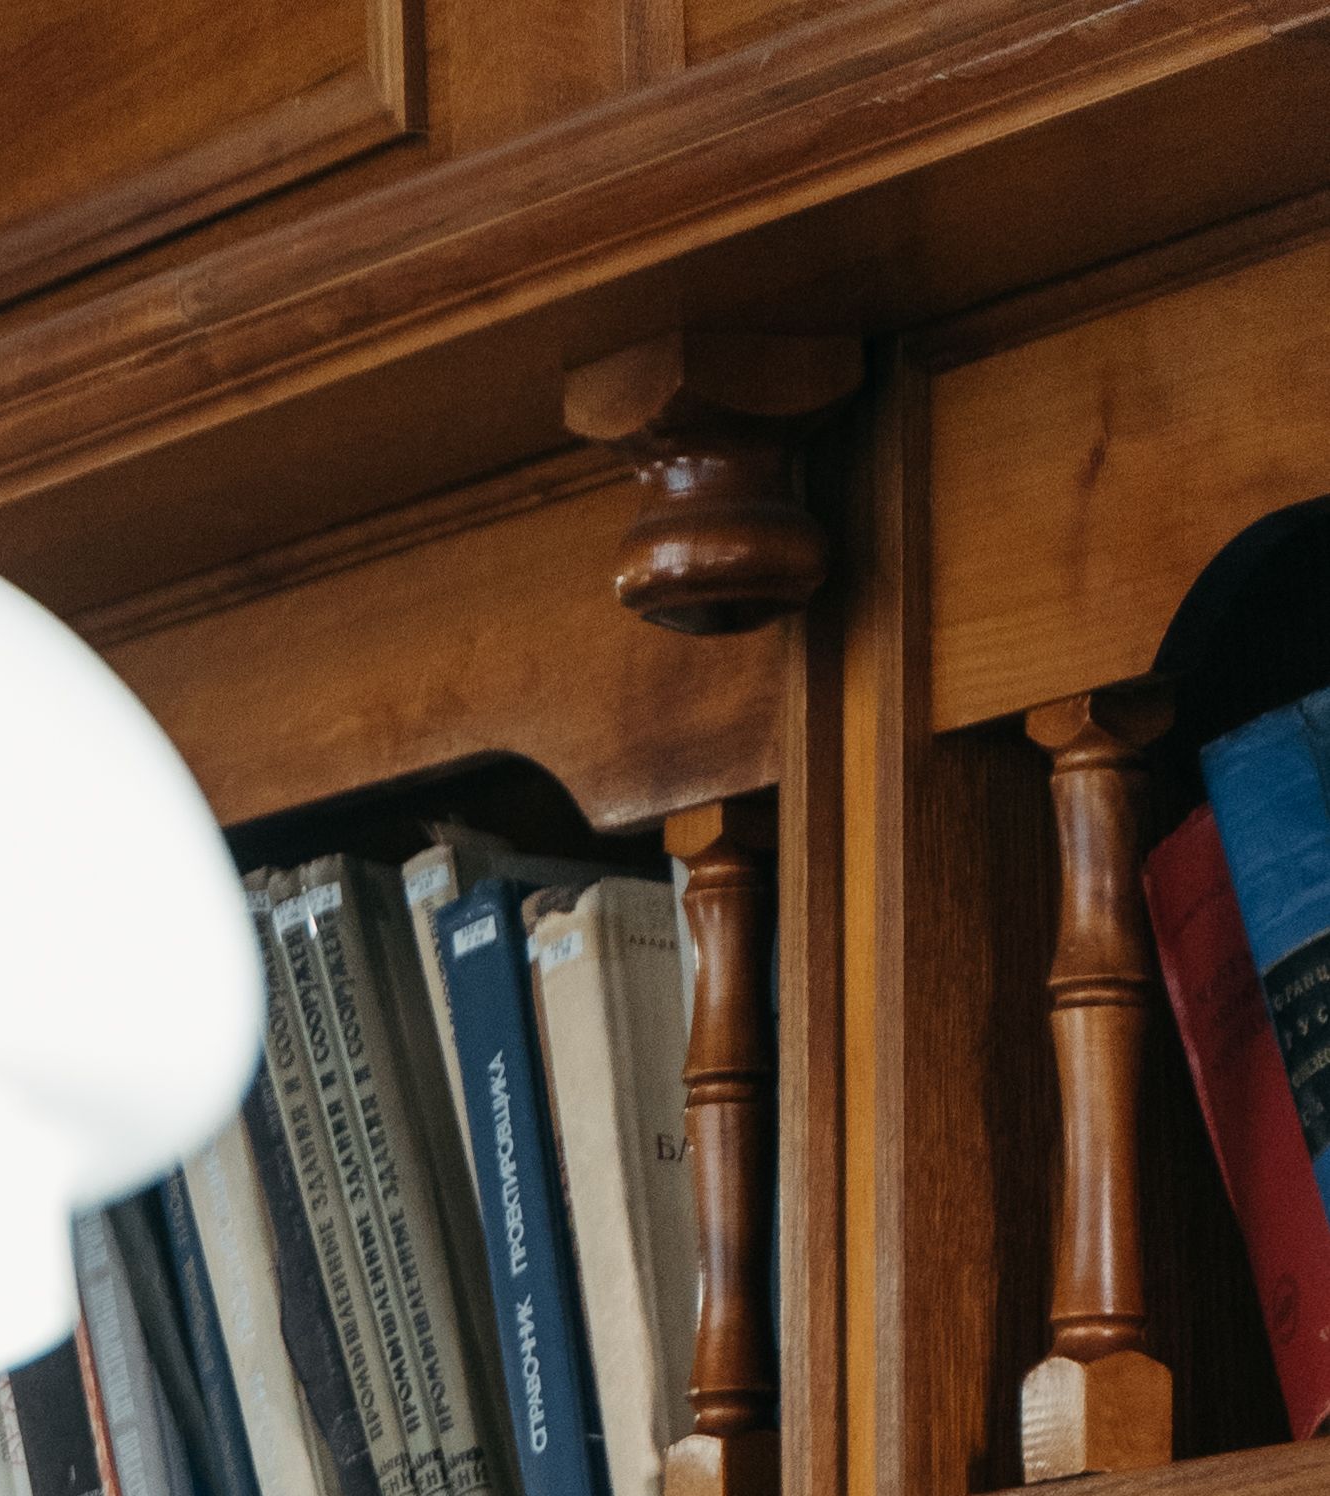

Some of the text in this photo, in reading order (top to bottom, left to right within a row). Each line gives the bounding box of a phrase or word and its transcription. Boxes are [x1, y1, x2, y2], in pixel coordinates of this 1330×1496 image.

[326, 1096, 367, 1202] ЗДАНИЯ
[486, 1048, 547, 1452] СПРАВОЧНИК ПРОЕКТИРОВЩИКА
[353, 1208, 421, 1436] ПРОМЫШЛЕННЫЕ
[391, 1205, 455, 1436] ПРОМЫШЛЕННЫЕ
